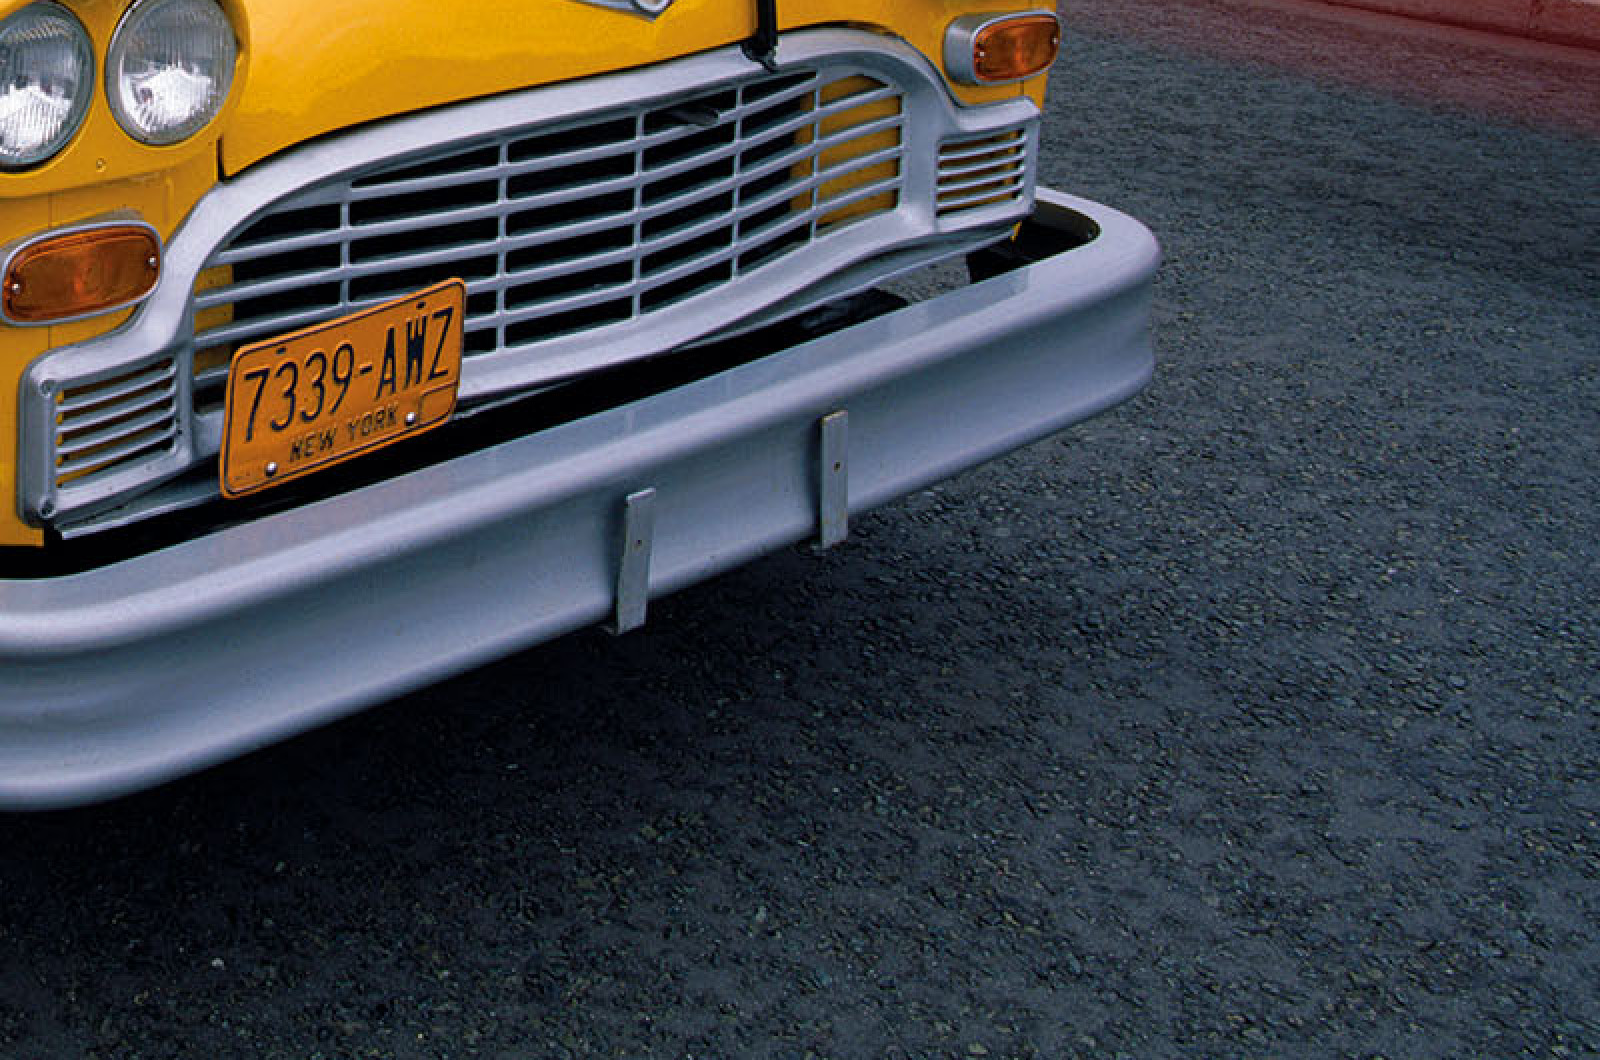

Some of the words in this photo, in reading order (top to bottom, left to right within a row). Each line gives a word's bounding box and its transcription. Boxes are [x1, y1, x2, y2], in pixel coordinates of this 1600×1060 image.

[244, 306, 454, 442] 7339-AWZ
[290, 428, 337, 462] NEW
[348, 401, 398, 441] YORK
